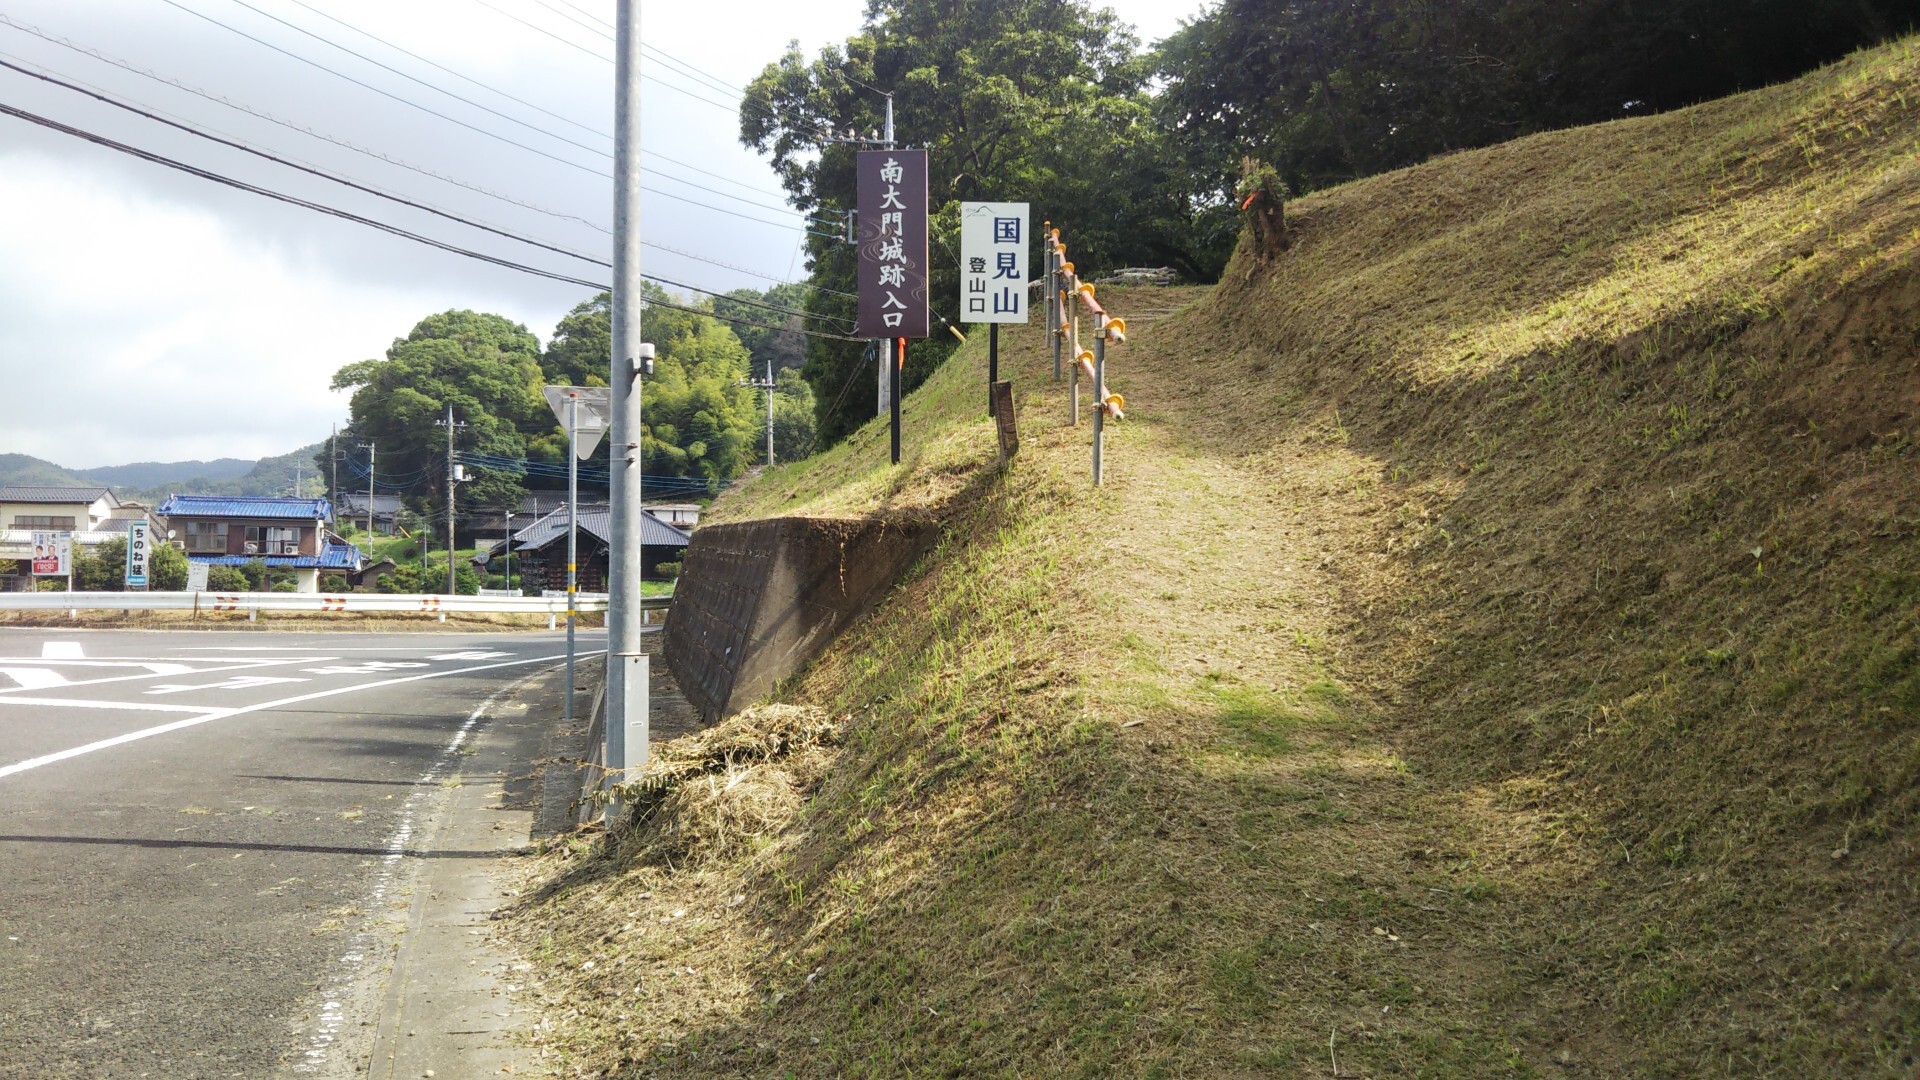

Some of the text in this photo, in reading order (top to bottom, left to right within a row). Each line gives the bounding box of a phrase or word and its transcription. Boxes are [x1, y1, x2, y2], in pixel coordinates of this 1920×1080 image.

[878, 157, 908, 328] 南大門城跡入口
[968, 256, 987, 313] 登山口
[992, 216, 1021, 315] 国見山
